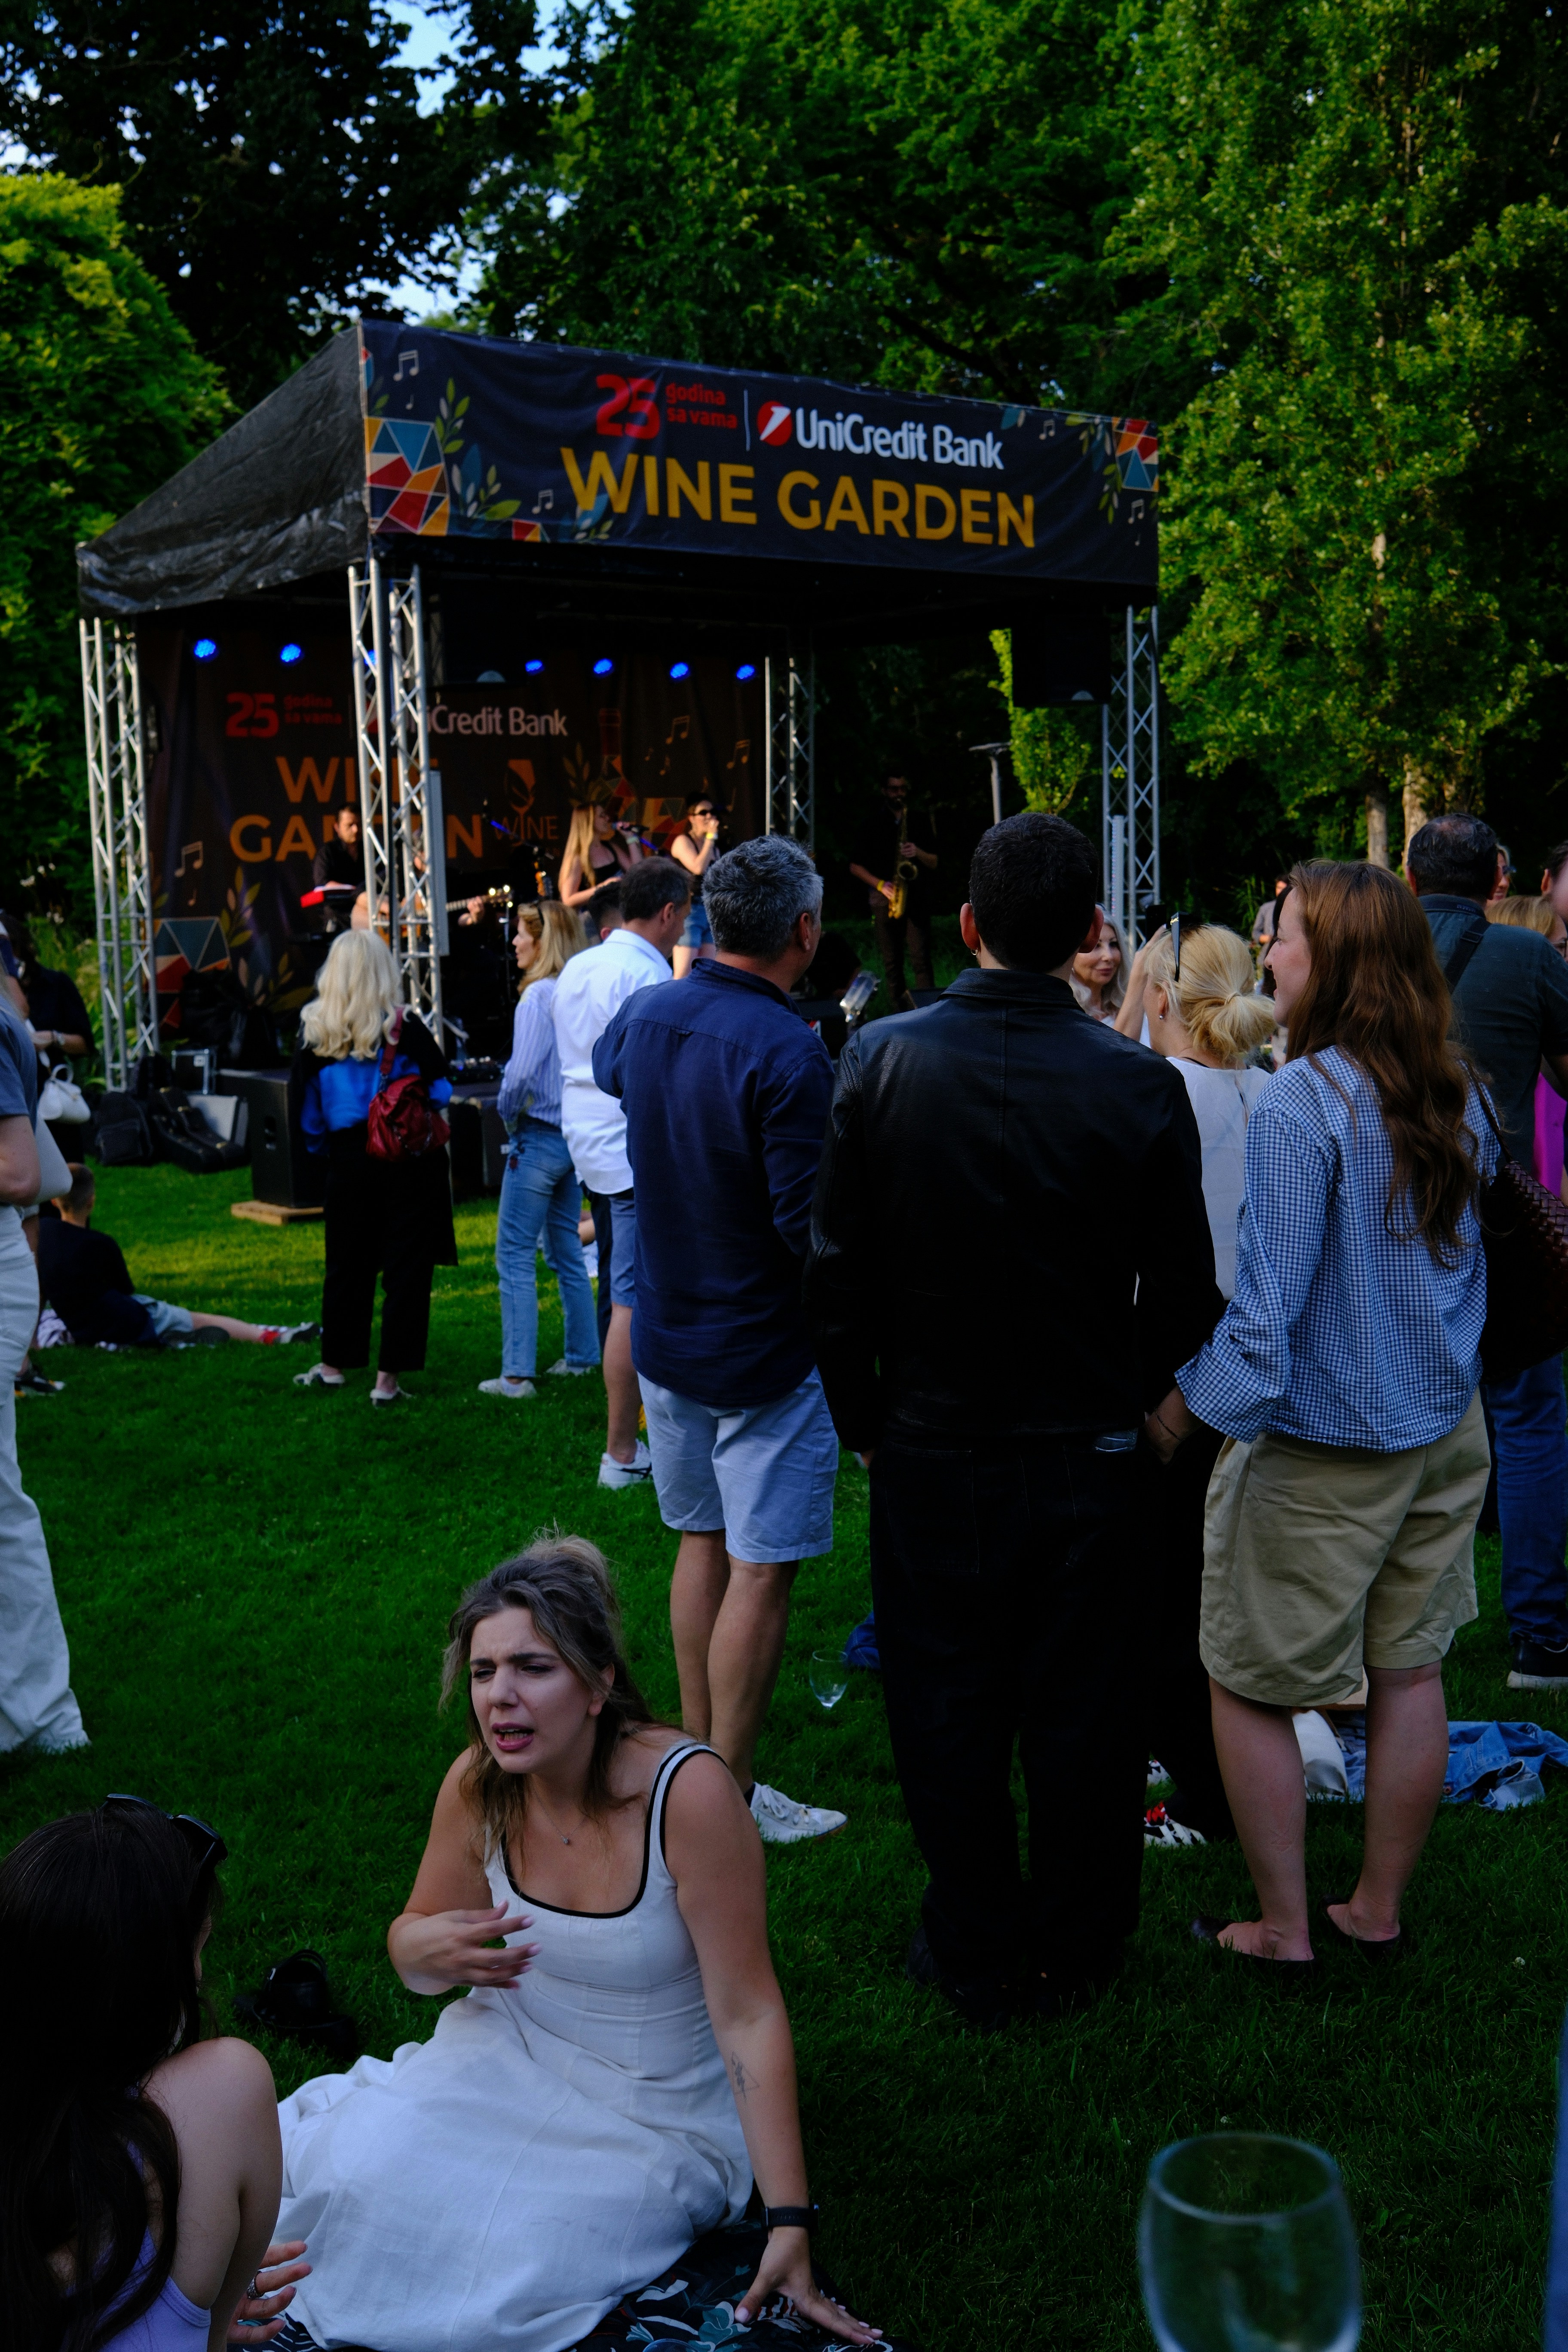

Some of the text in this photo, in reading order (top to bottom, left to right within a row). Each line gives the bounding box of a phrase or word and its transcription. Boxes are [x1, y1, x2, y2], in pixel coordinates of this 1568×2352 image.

[595, 373, 661, 440] 25
[665, 381, 726, 406] godina
[667, 407, 738, 429] sa vama
[795, 406, 1005, 470] UniCredit Bank
[559, 446, 1035, 549] WINE GARDEN
[225, 691, 280, 739] 25
[508, 706, 568, 737] Bank
